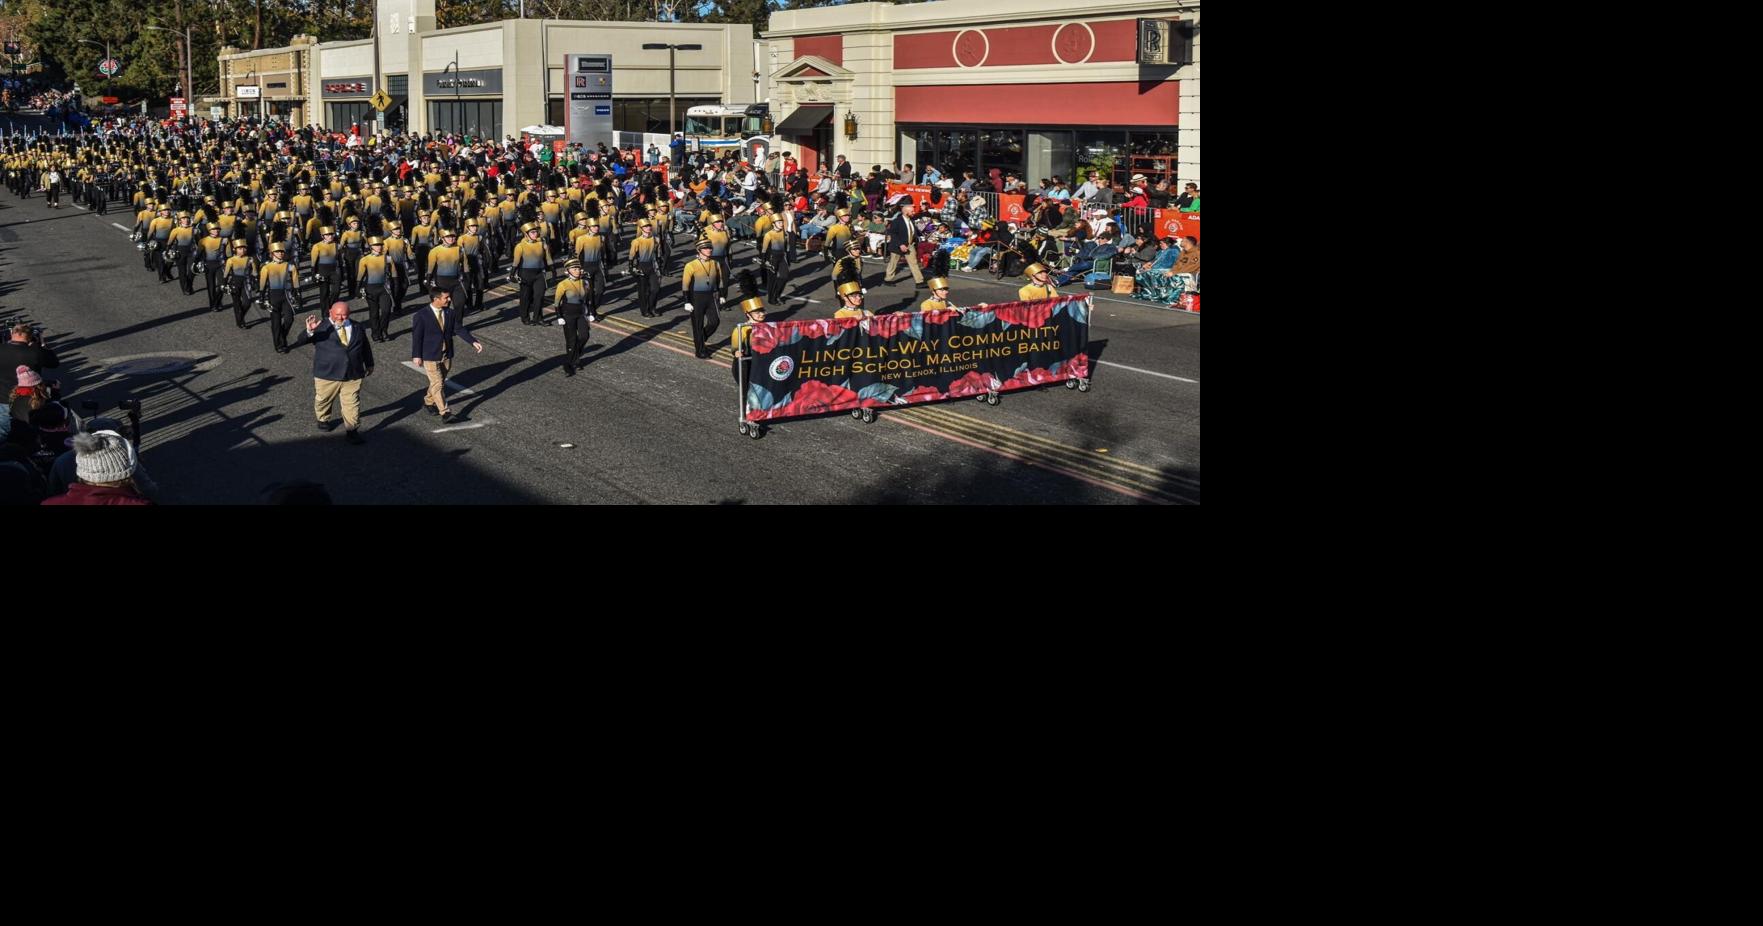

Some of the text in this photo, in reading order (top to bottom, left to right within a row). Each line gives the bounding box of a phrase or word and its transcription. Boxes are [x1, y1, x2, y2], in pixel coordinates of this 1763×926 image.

[798, 365, 845, 378] HIGH
[851, 358, 921, 374] SCHOOL
[926, 347, 1012, 366] MARCHING
[1018, 341, 1060, 354] BAND
[801, 325, 1060, 363] LINCOLN-WAY COMMUNITY
[881, 362, 978, 381] NEW LENOX, ILLINOIS
